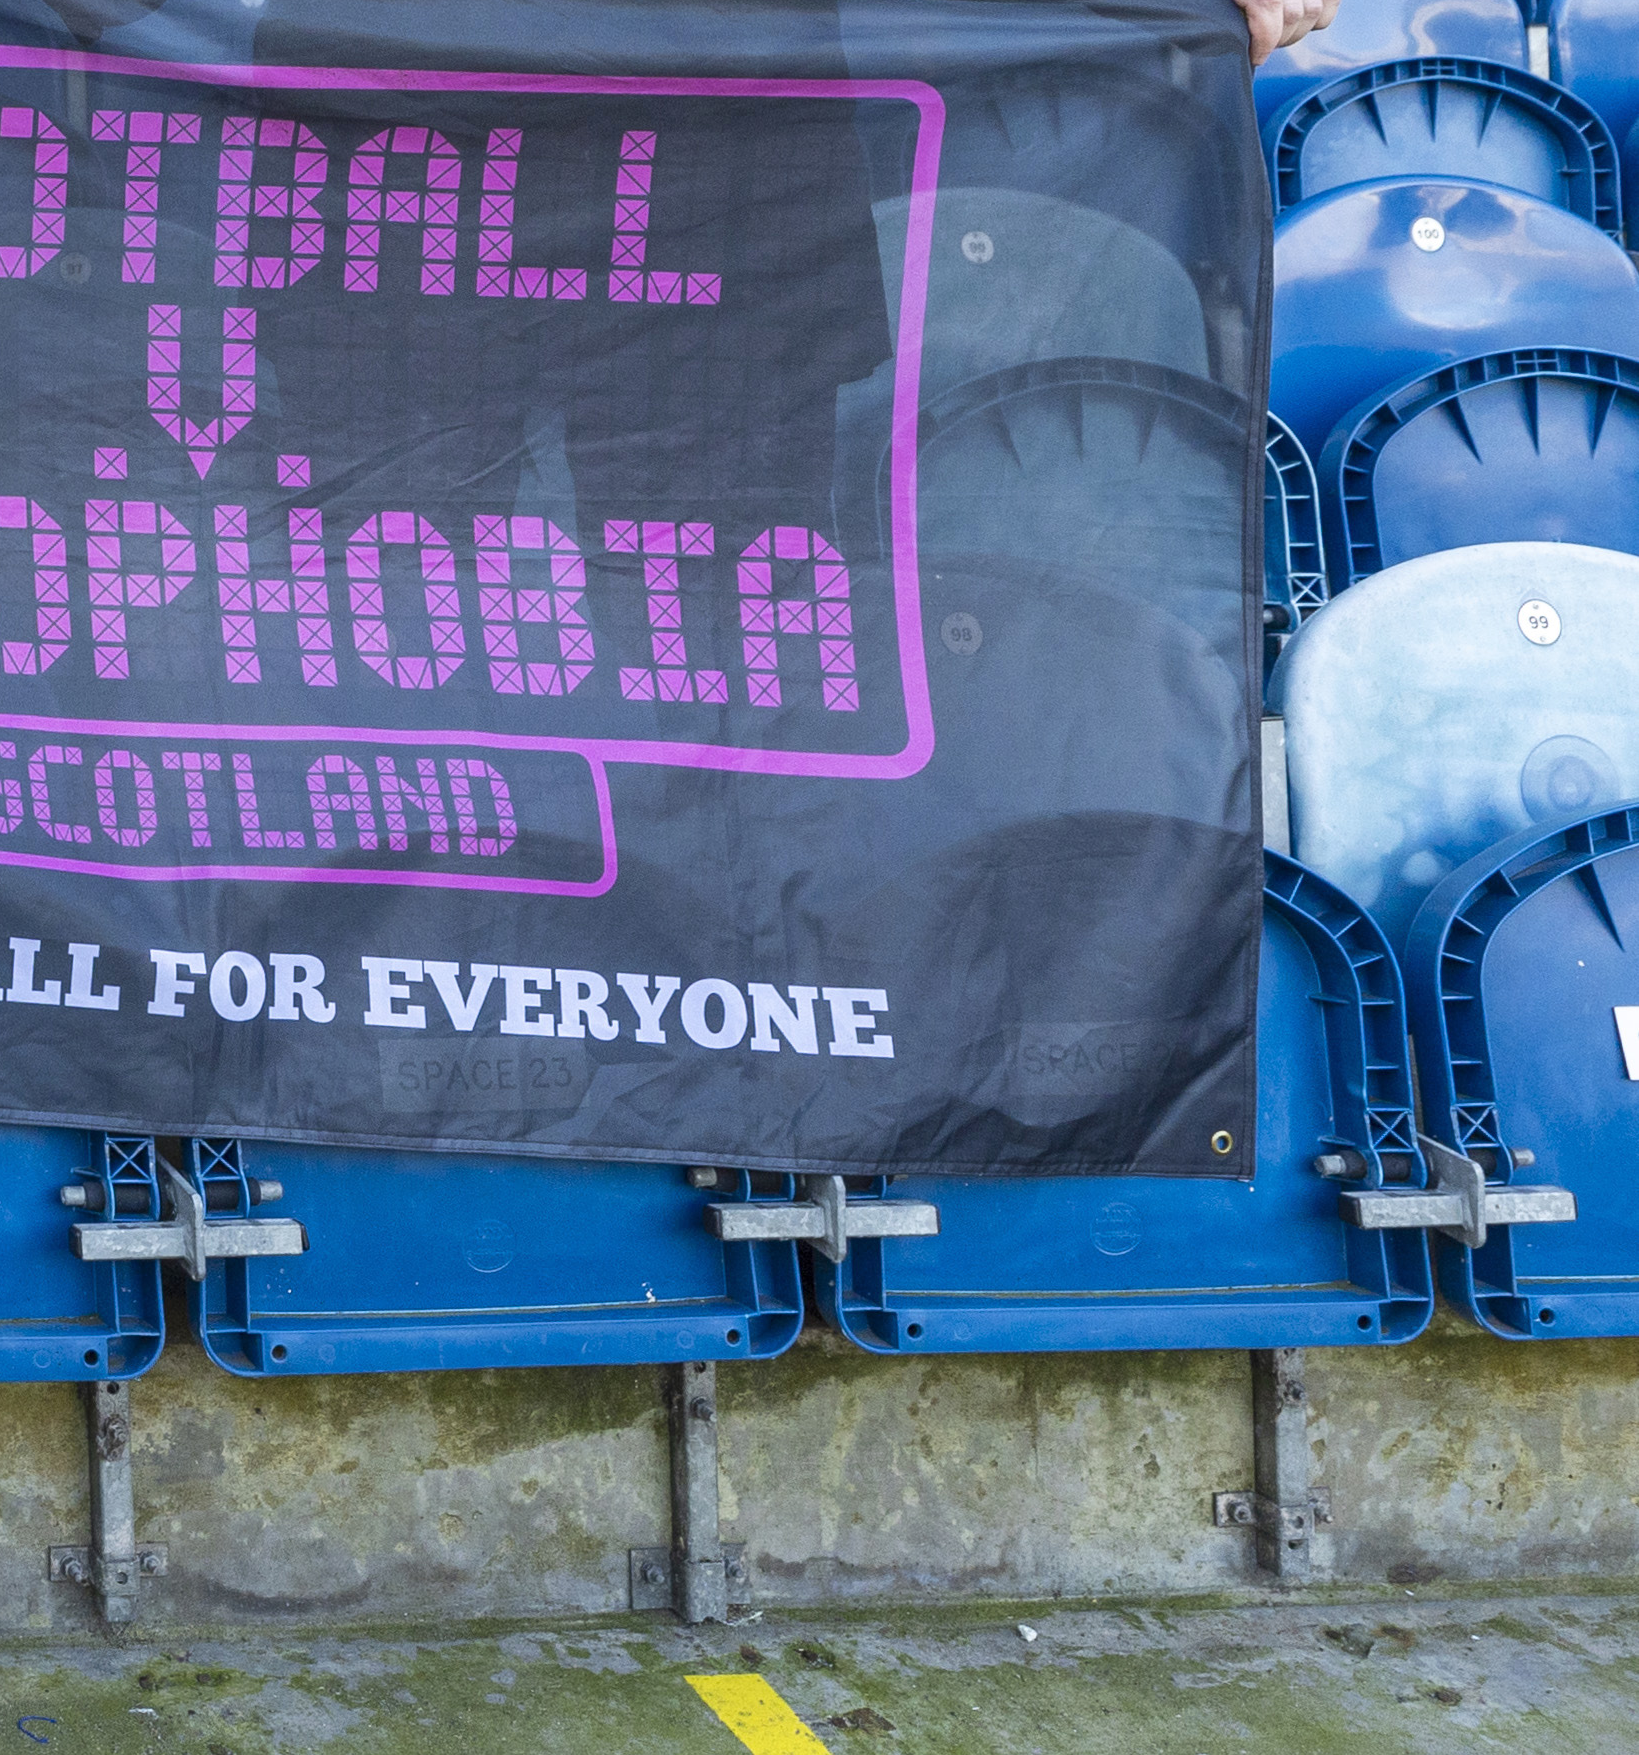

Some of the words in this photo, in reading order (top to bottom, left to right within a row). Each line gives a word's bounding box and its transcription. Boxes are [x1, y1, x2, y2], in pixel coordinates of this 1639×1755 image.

[1417, 228, 1439, 239] 100
[1528, 615, 1549, 629] 99
[147, 949, 336, 1022] FOR
[362, 957, 895, 1058] EVERYONE
[397, 1059, 517, 1091] SPACE
[529, 1056, 572, 1088] 23
